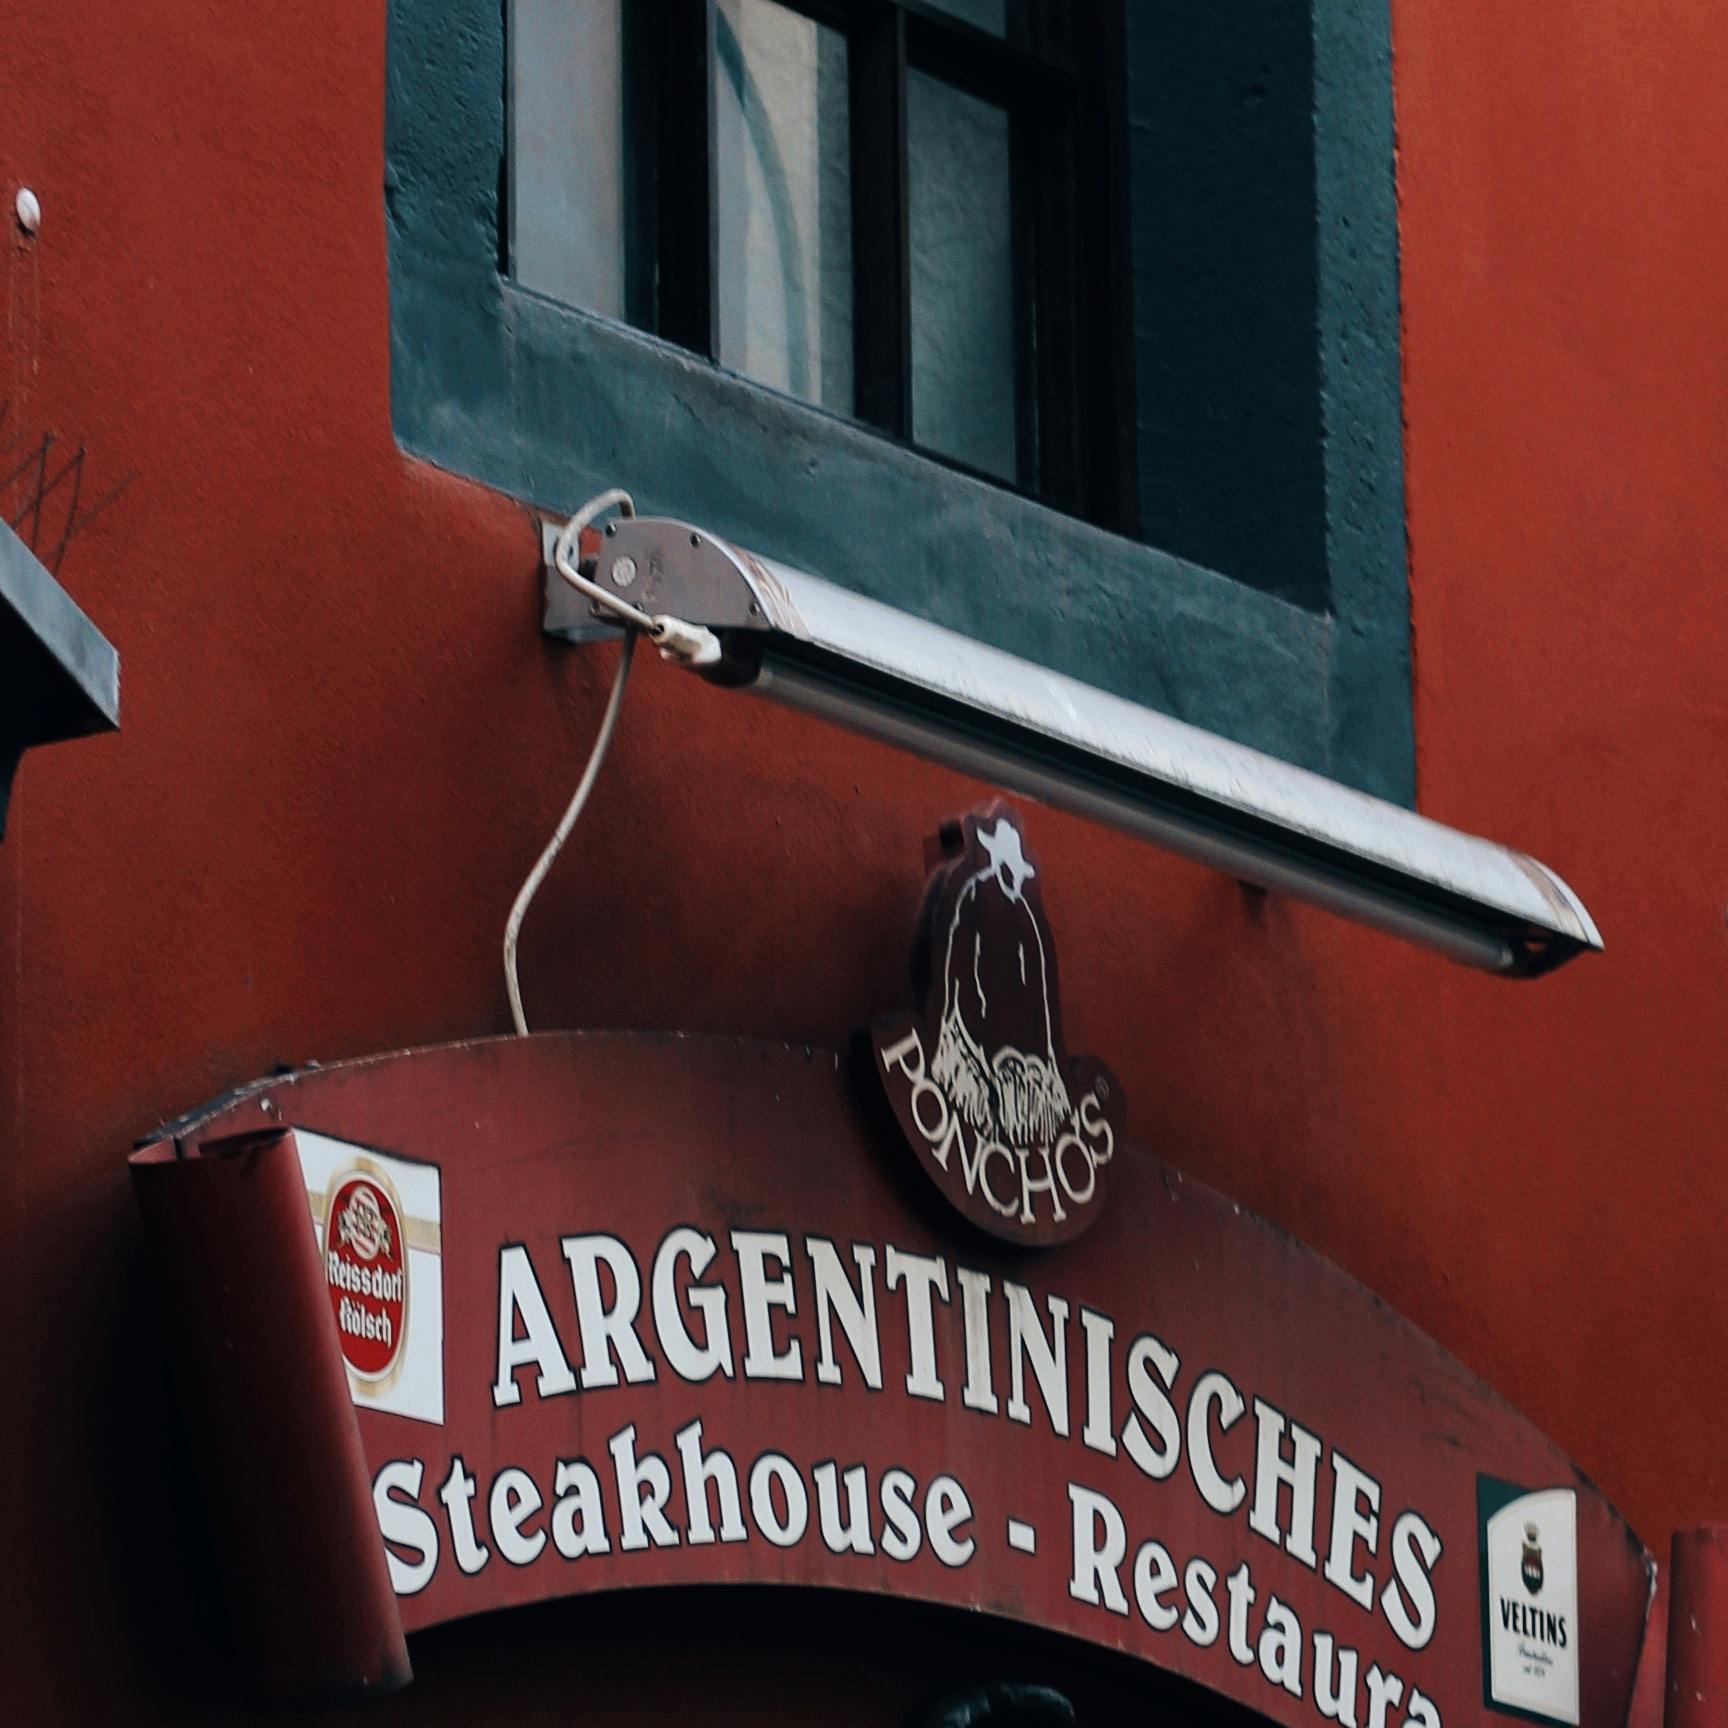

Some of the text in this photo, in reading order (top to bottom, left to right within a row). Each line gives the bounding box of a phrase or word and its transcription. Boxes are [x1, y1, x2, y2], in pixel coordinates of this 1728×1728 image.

[329, 1250, 404, 1303] Reissdorf
[339, 1295, 392, 1349] Kölsch
[493, 1229, 1442, 1649] ARGENTINISCHES
[372, 1420, 977, 1595] Steakhouse
[1500, 1596, 1567, 1648] VELTINS
